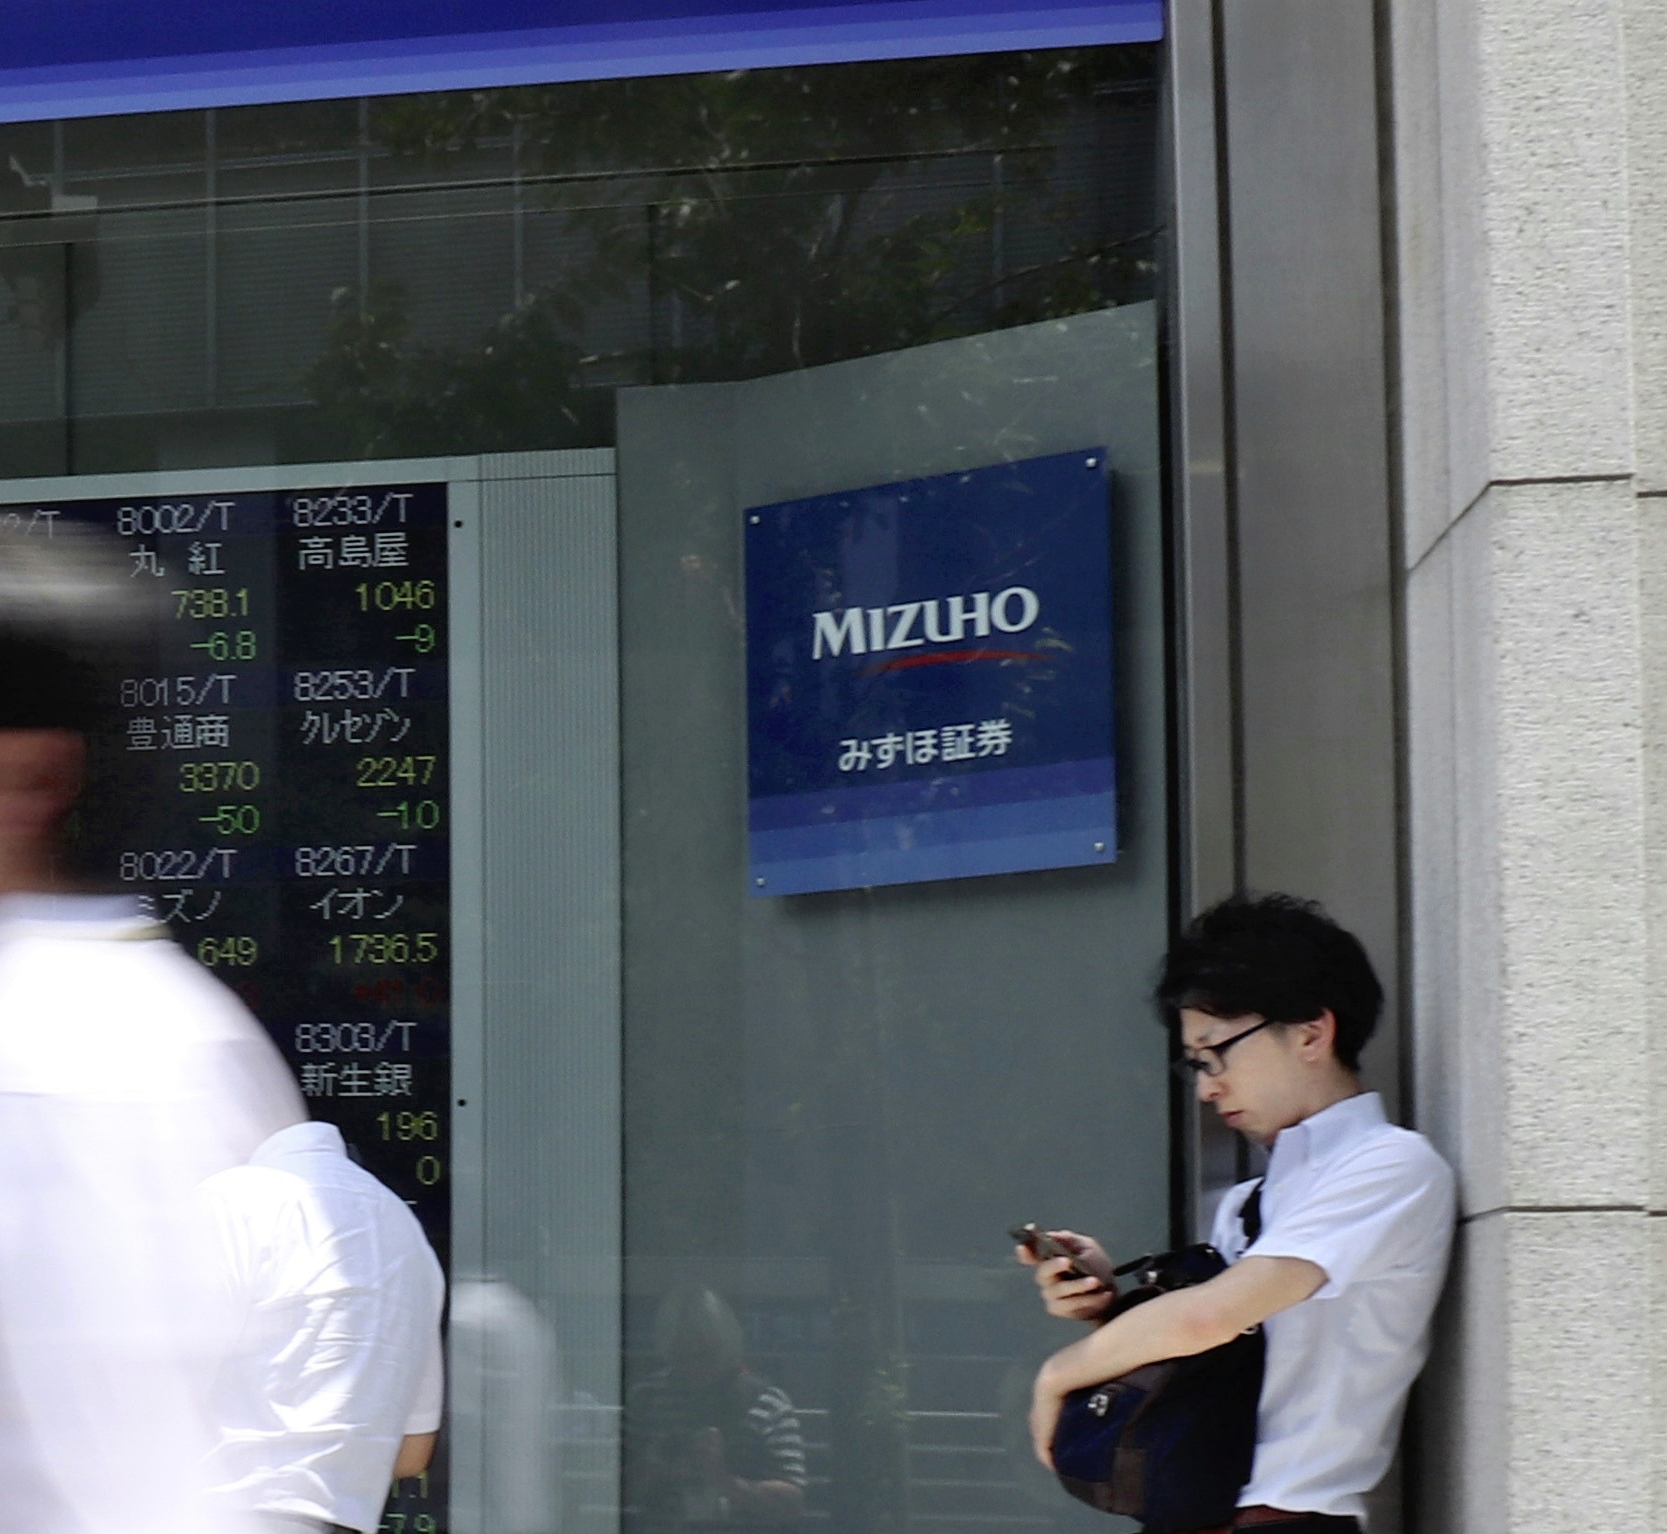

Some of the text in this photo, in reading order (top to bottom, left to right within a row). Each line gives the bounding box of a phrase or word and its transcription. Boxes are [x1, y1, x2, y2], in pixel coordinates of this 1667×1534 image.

[117, 501, 235, 536] 8002/T
[293, 492, 413, 528] 8233/T
[298, 533, 410, 570] 高島屋
[171, 588, 249, 619] 738.1
[356, 580, 435, 612] 1046
[395, 624, 435, 653] -9
[811, 586, 1040, 660] MIZUHO
[191, 631, 256, 662] -6.8
[120, 673, 236, 708] 8015/T
[294, 667, 415, 701] 8253/T
[126, 715, 229, 751] 豊通商
[300, 709, 410, 745] クレセゾン
[838, 717, 1013, 773] みずほ証券
[180, 762, 259, 793] 3370
[356, 756, 436, 788] 2247
[198, 805, 260, 835] -50
[377, 800, 439, 830] -10
[120, 847, 237, 881] 8022/T
[295, 843, 417, 878] 8267/T
[309, 888, 403, 921] イオン
[198, 937, 258, 967] 649
[329, 932, 438, 964] 1736.5
[301, 1063, 413, 1098] 新生銀
[377, 1112, 438, 1142] 196
[416, 1156, 440, 1185] 0
